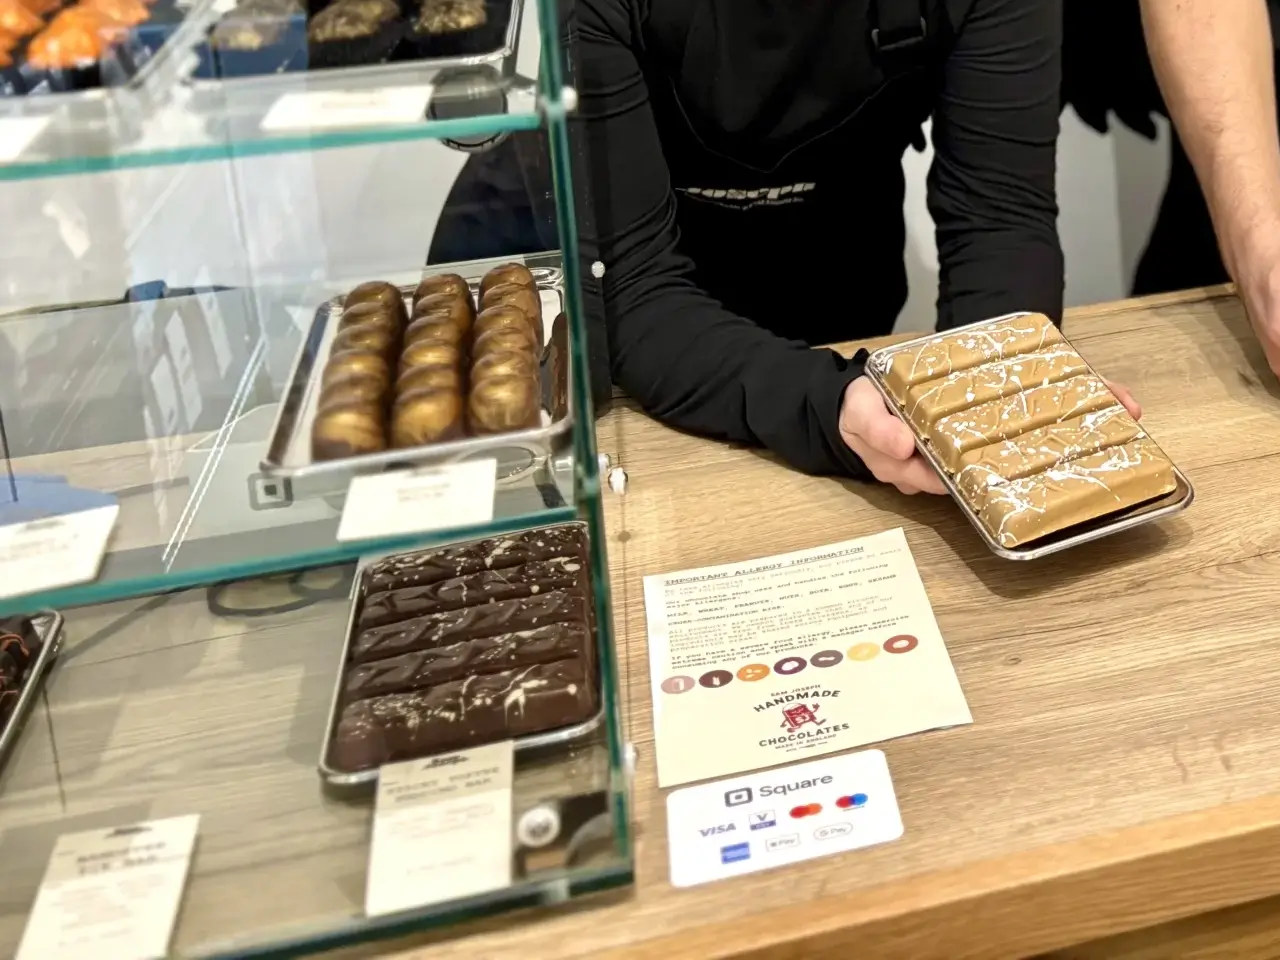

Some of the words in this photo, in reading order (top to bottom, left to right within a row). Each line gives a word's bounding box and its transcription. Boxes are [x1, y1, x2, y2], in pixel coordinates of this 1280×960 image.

[665, 572, 728, 586] IMPORTANT
[735, 563, 783, 576] ALLERGY
[791, 546, 864, 565] INFORMATION
[790, 684, 821, 694] JOSEPH
[753, 690, 841, 712] HANDMADE
[759, 723, 850, 747] CHOCOLATES
[759, 775, 834, 798] Square
[698, 823, 737, 837] VISA
